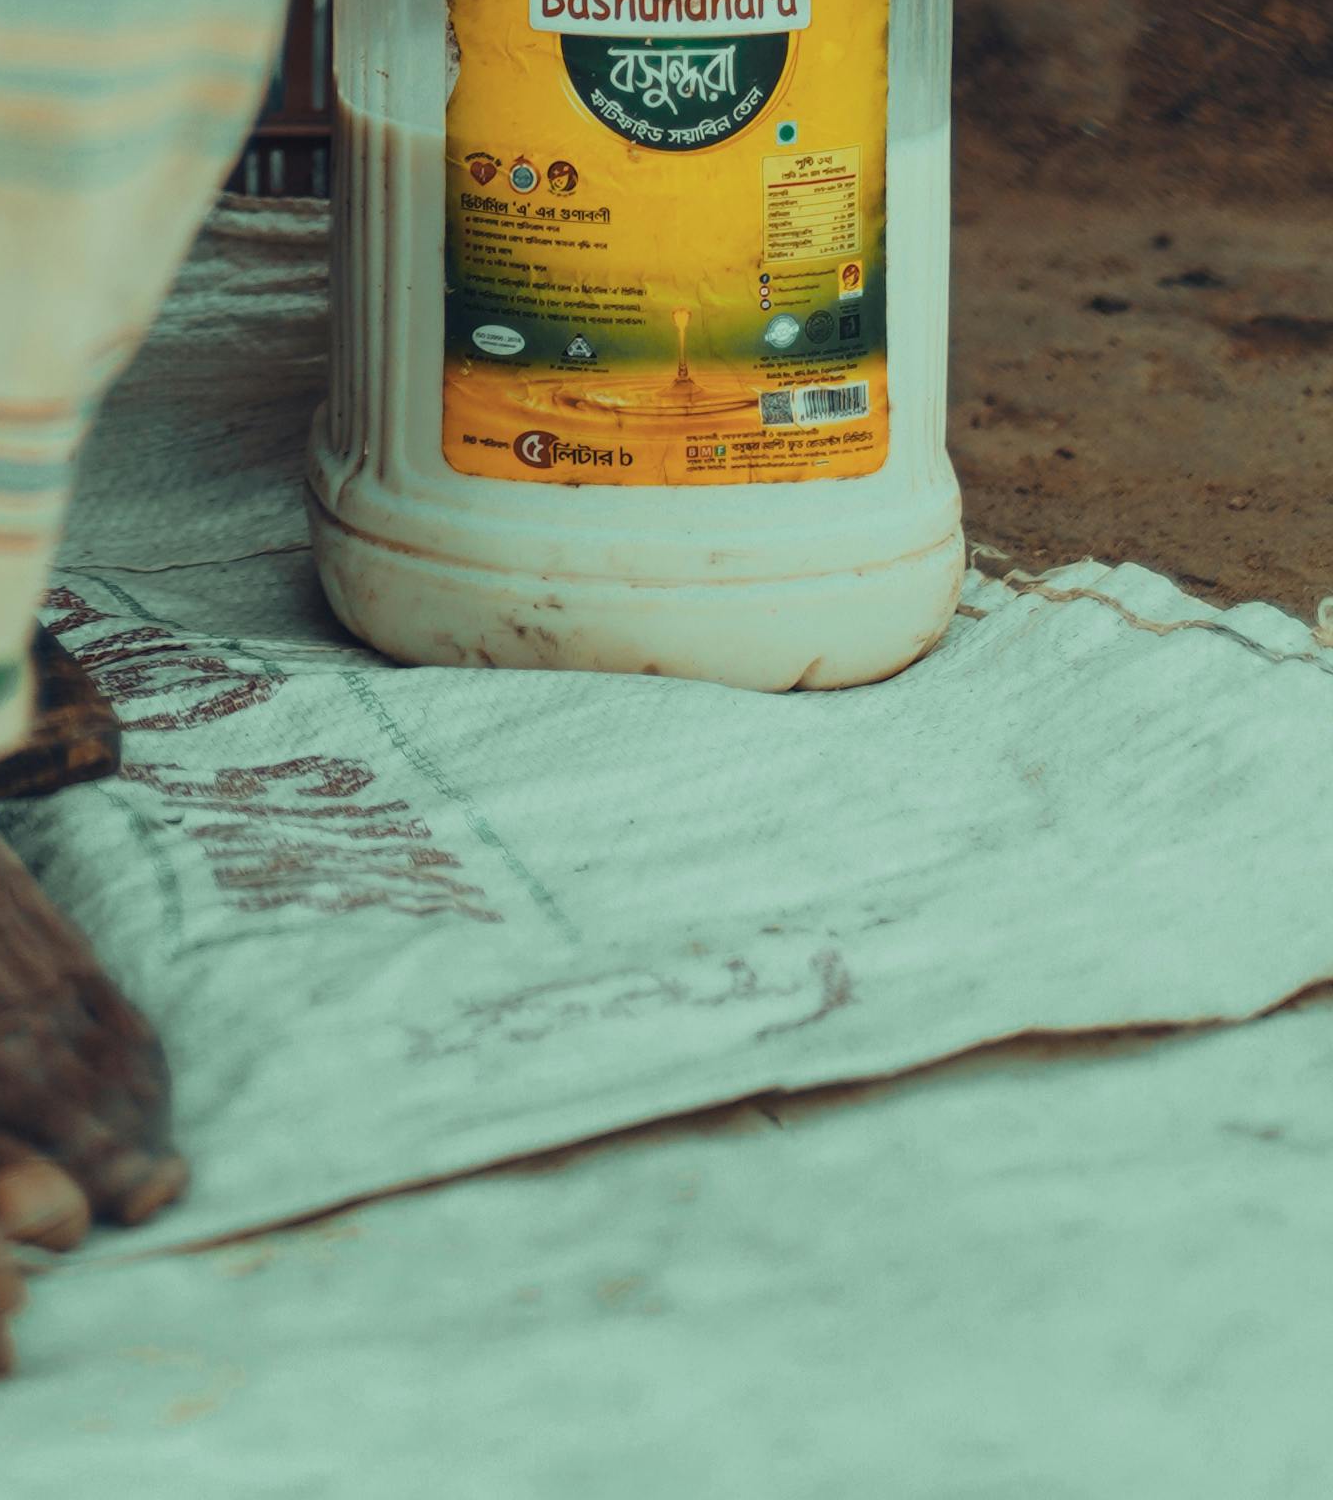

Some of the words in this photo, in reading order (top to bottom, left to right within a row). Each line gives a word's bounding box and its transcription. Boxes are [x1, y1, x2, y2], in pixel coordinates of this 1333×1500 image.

[607, 44, 737, 116] বসুন্ধরা
[732, 85, 765, 122] তেল
[535, 204, 556, 220] এর
[559, 206, 611, 223] গুণাবলী
[521, 434, 545, 463] ৫
[552, 441, 615, 467] লিটার
